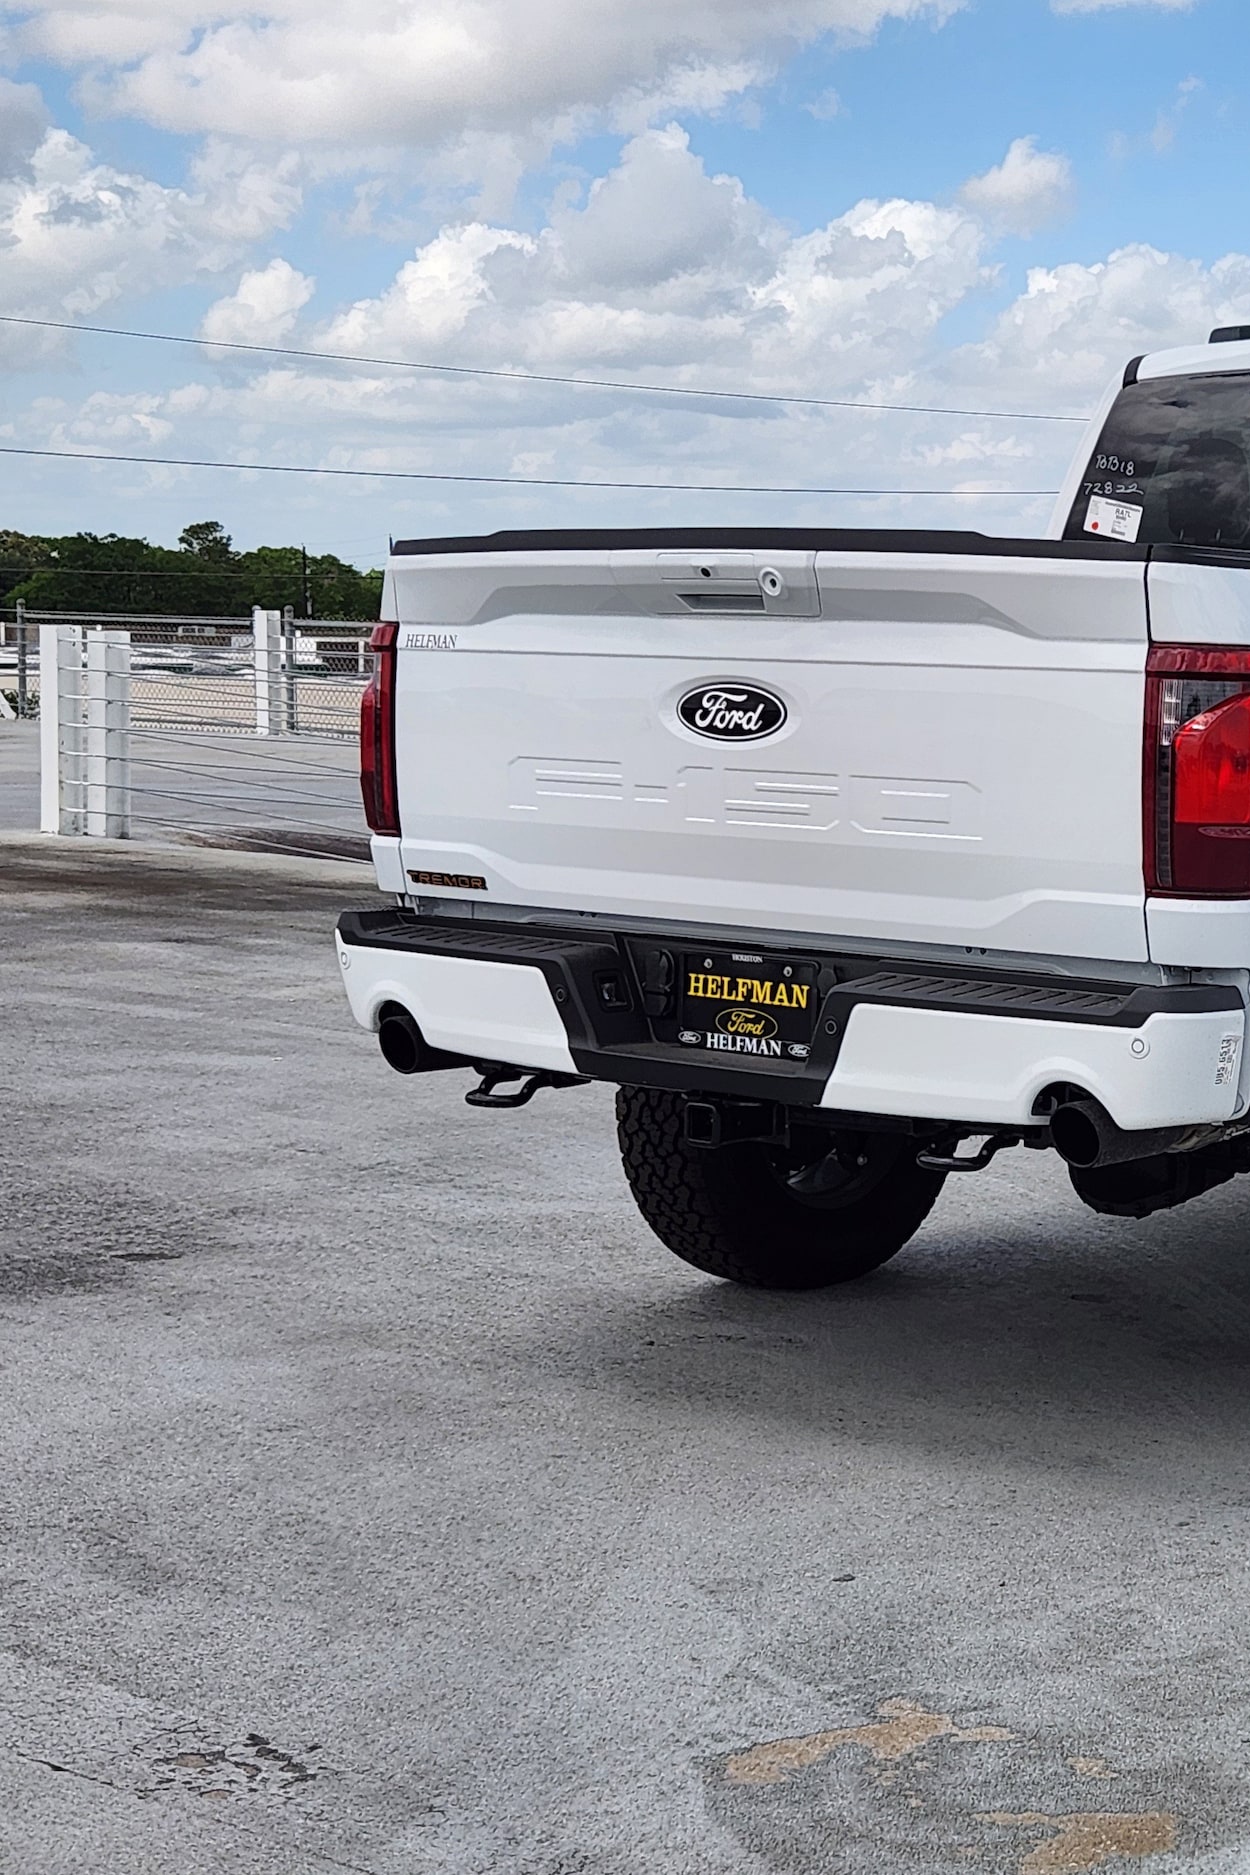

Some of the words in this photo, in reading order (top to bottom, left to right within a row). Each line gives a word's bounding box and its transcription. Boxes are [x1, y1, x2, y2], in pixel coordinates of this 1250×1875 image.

[405, 634, 458, 649] HELFMAN
[694, 690, 766, 731] Ford
[506, 755, 985, 841] F-150
[406, 869, 488, 891] TREMOR
[687, 972, 810, 1009] HELFMAN
[727, 1011, 765, 1036] Ford
[706, 1032, 782, 1056] HELFMAN
